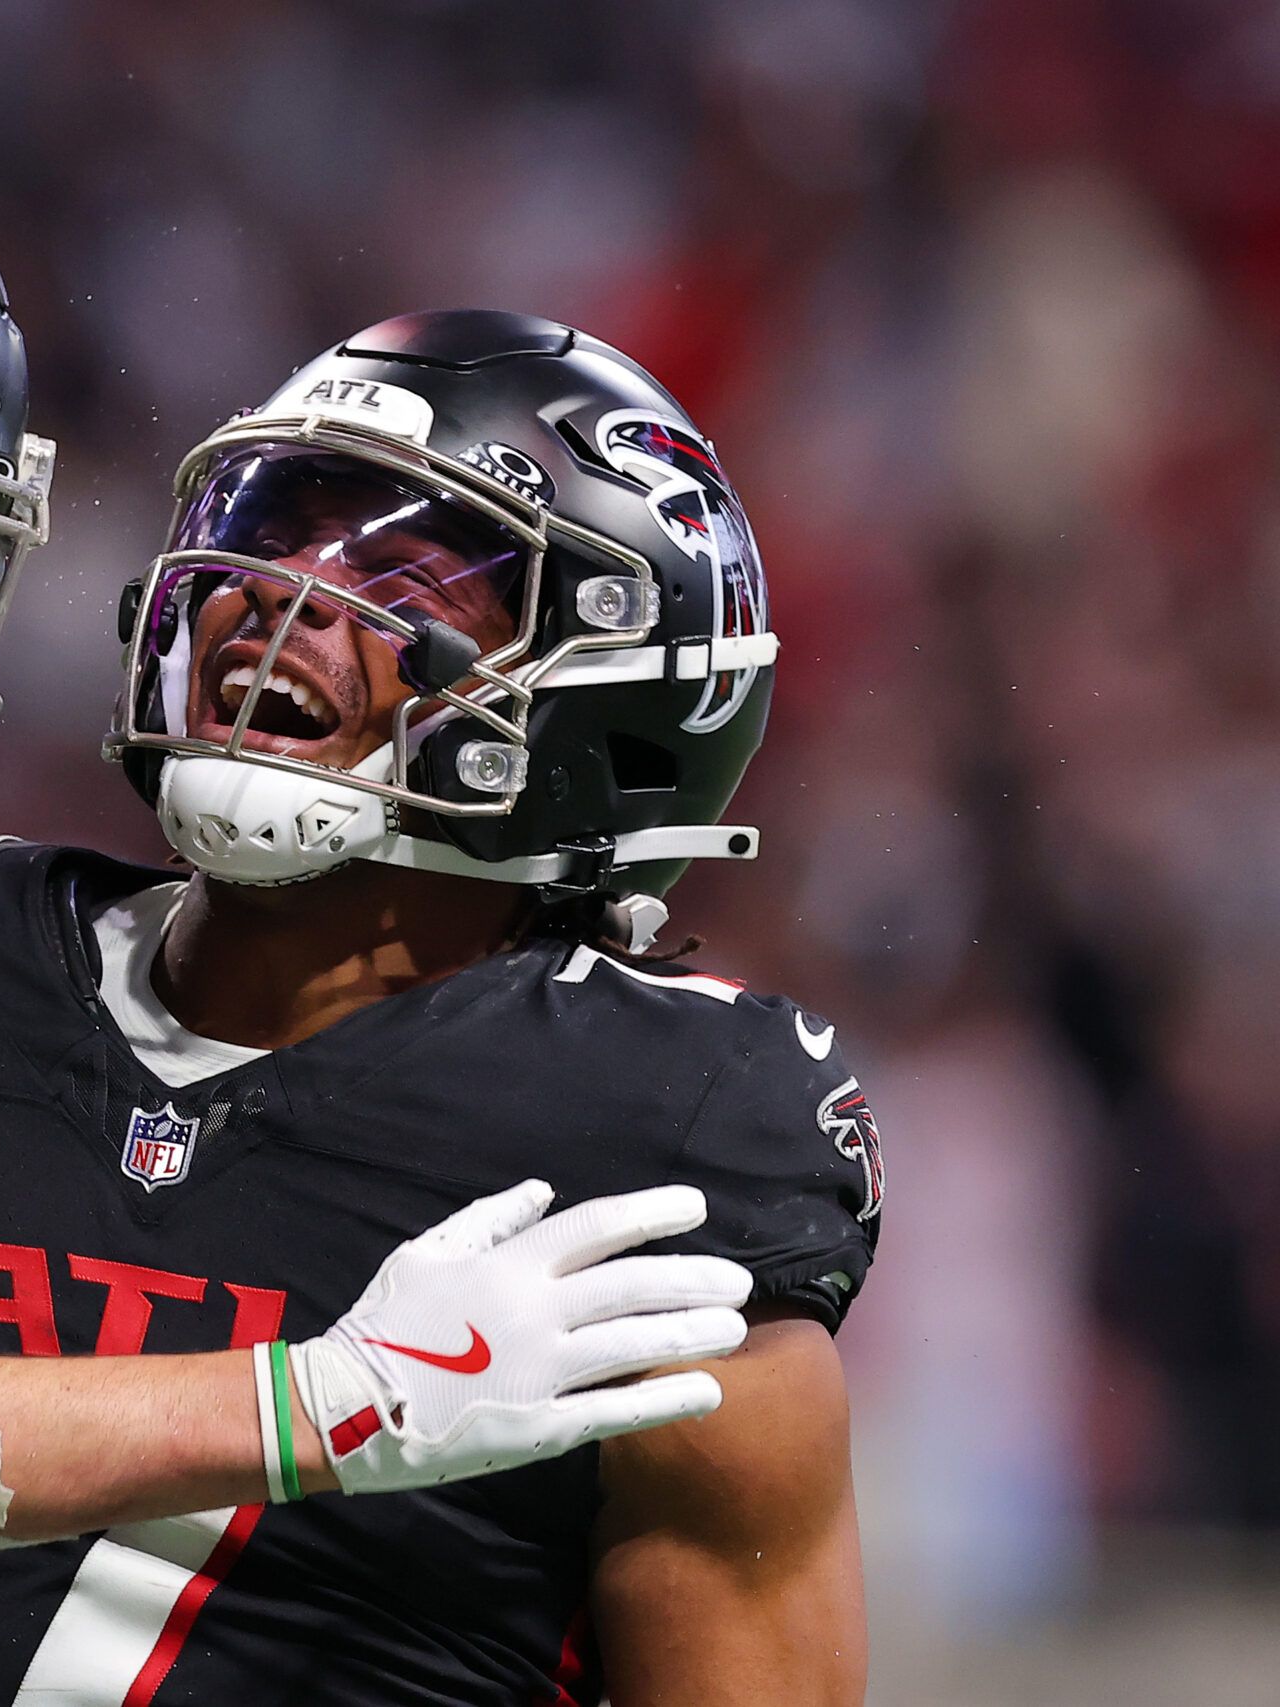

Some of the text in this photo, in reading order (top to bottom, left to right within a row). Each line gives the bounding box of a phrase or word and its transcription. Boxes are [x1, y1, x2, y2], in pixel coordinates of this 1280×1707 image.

[303, 378, 382, 408] ATL
[461, 450, 551, 508] OAKLEY
[130, 1139, 179, 1176] NFL
